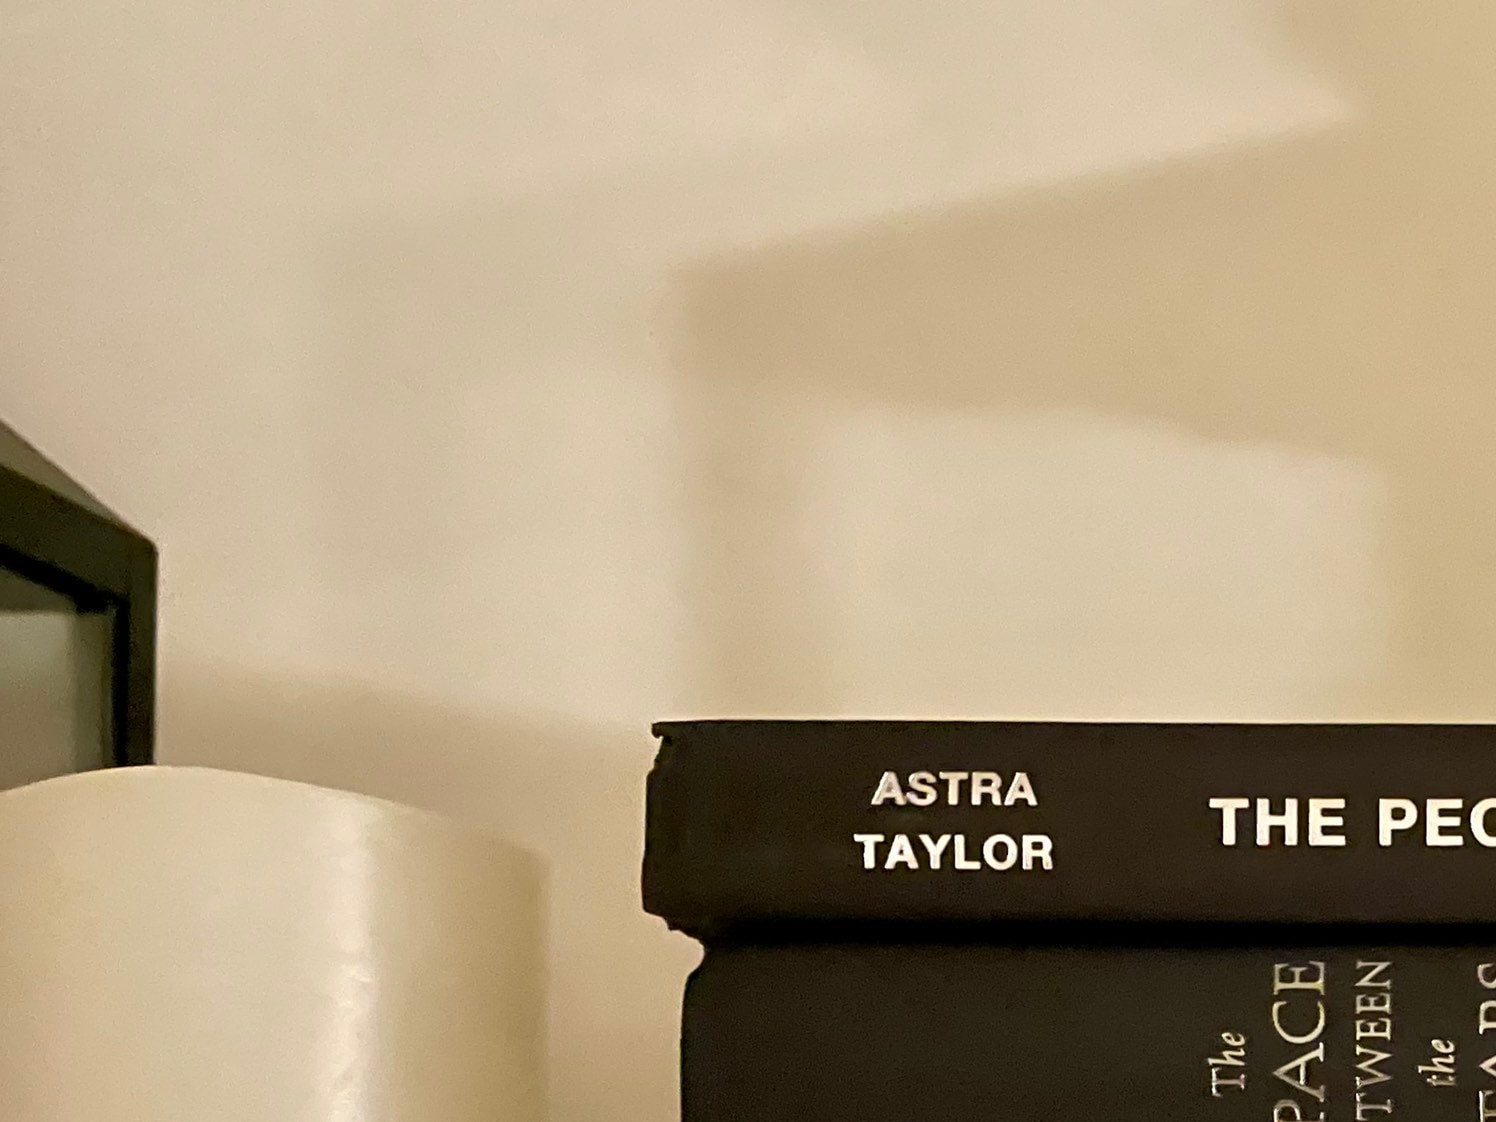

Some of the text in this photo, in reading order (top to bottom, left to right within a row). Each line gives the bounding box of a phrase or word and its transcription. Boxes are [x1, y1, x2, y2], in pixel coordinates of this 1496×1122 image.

[870, 771, 1038, 807] ASTRA
[1208, 797, 1347, 847] THE
[853, 833, 1054, 871] TAYLOR
[1207, 1031, 1246, 1097] The
[1417, 1038, 1456, 1087] the
